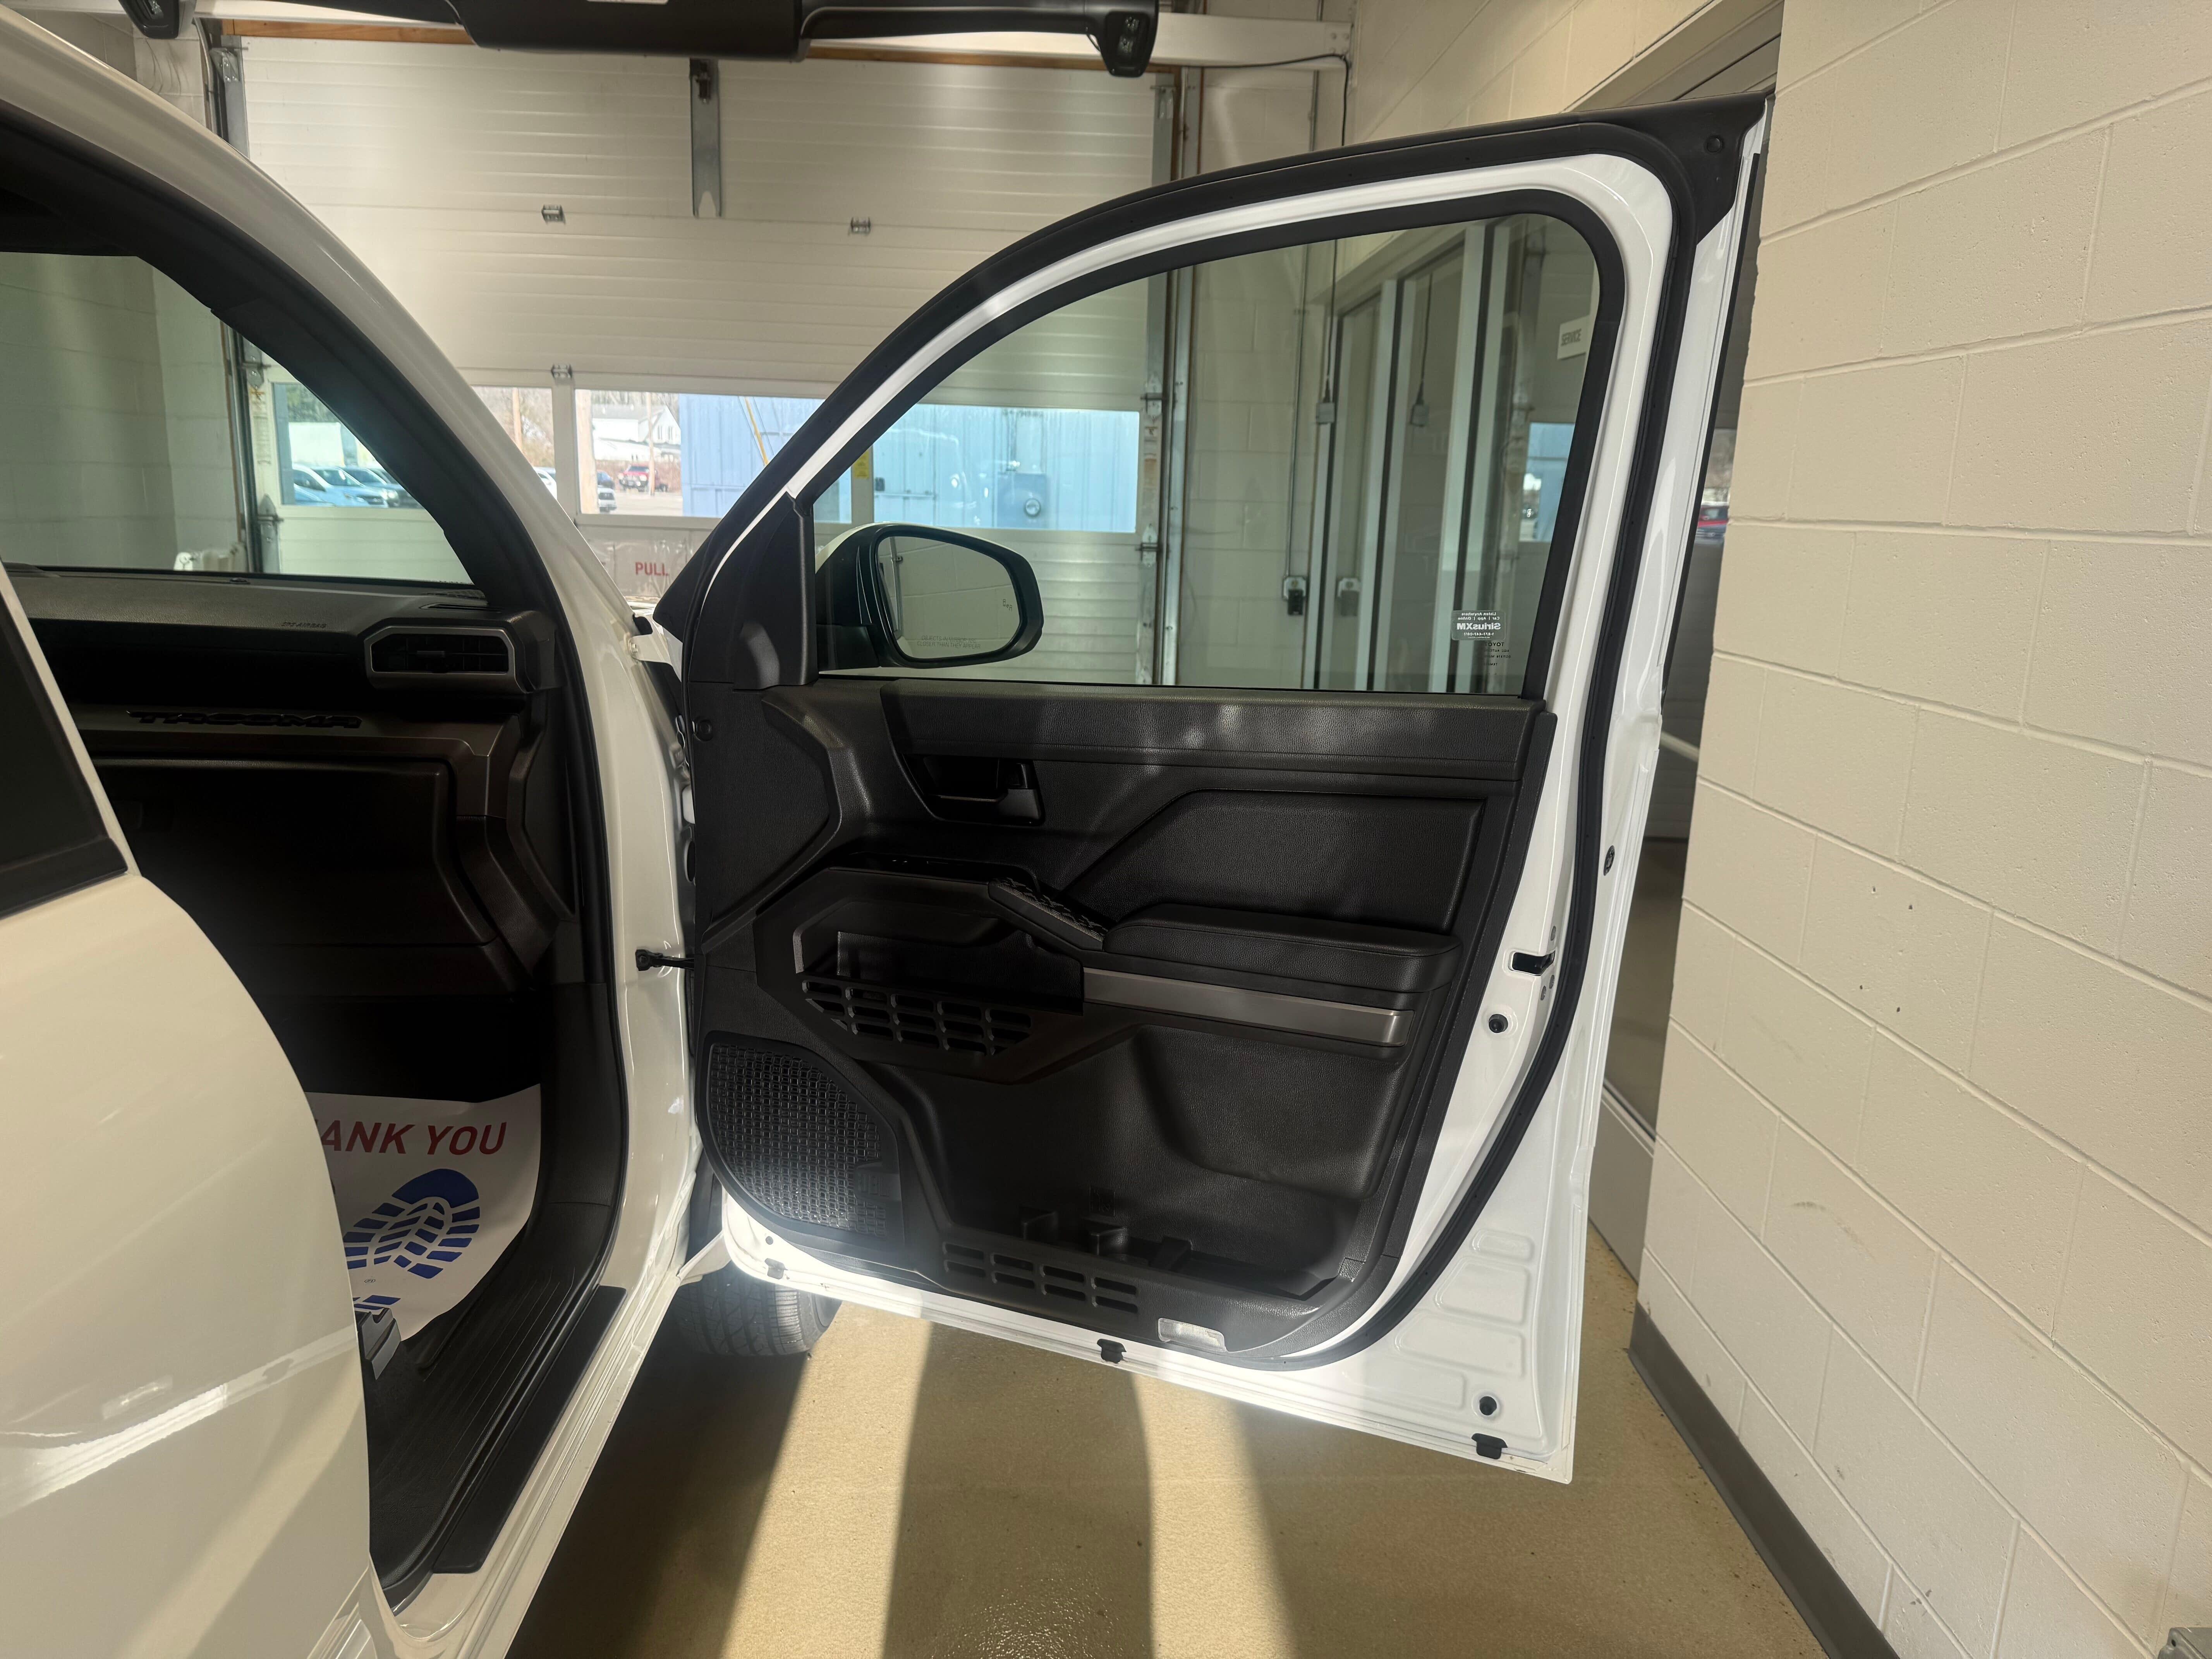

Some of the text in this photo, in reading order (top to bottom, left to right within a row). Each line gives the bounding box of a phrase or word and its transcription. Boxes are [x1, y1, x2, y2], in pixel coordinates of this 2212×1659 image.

[1561, 328, 1581, 346] SERVICE
[635, 562, 669, 576] PULL
[316, 1120, 507, 1155] ANK YOU
